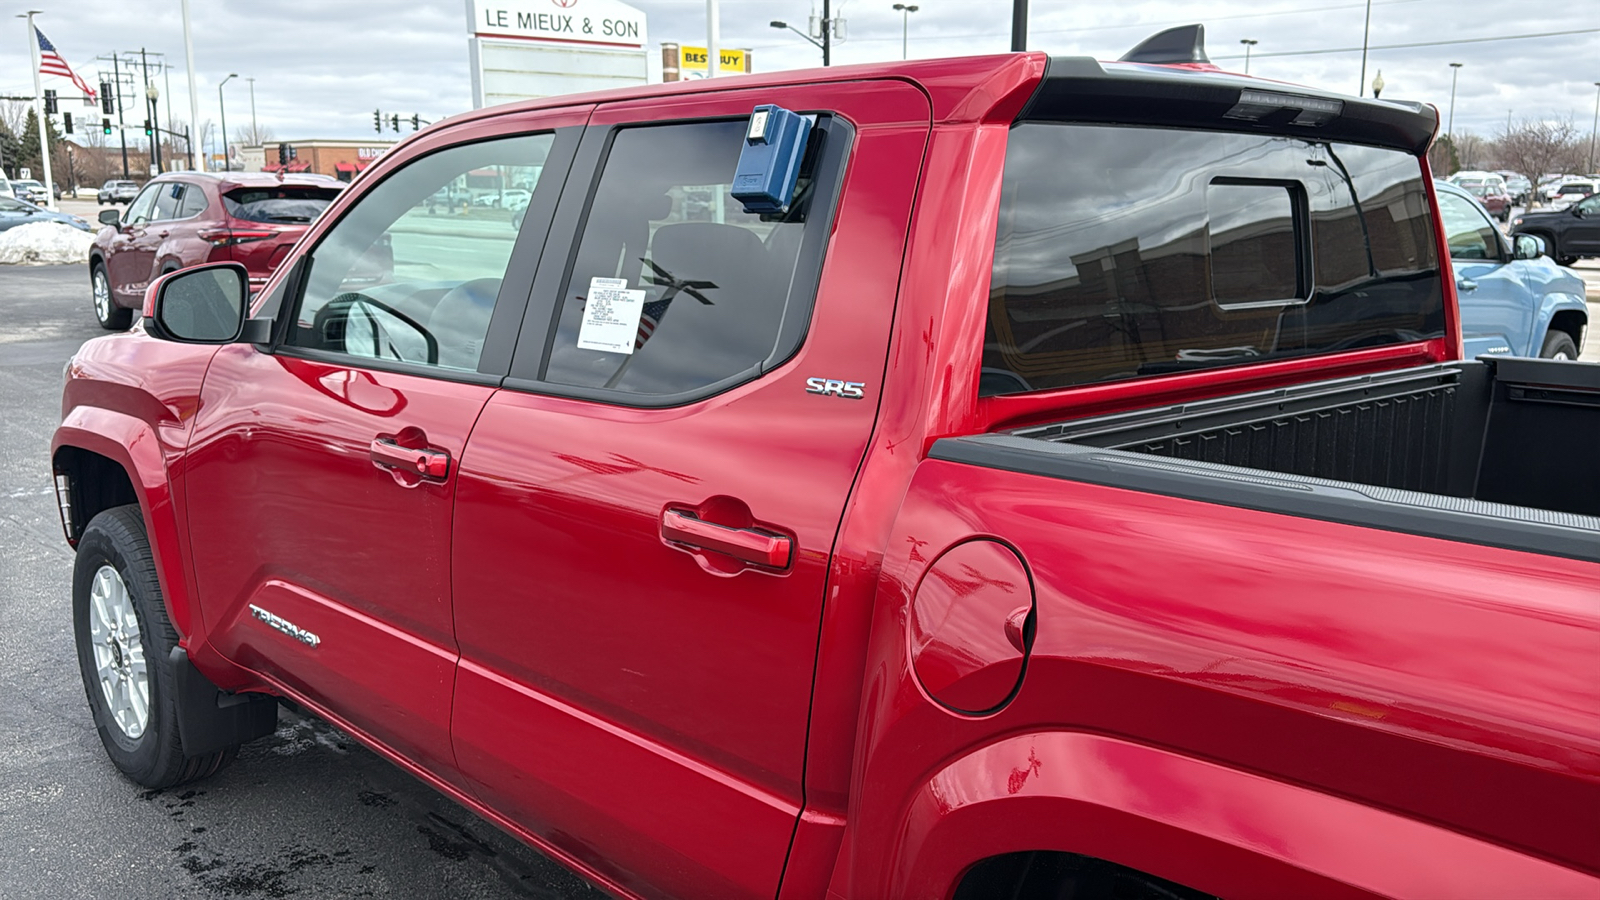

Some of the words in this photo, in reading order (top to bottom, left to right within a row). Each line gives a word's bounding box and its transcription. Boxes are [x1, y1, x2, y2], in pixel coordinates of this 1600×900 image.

[485, 8, 509, 28] LE
[517, 12, 574, 33] MIEUX
[582, 17, 594, 35] &
[602, 18, 639, 38] SON
[358, 147, 372, 158] OLD
[805, 376, 866, 400] SR5
[248, 603, 322, 649] TACOMA
